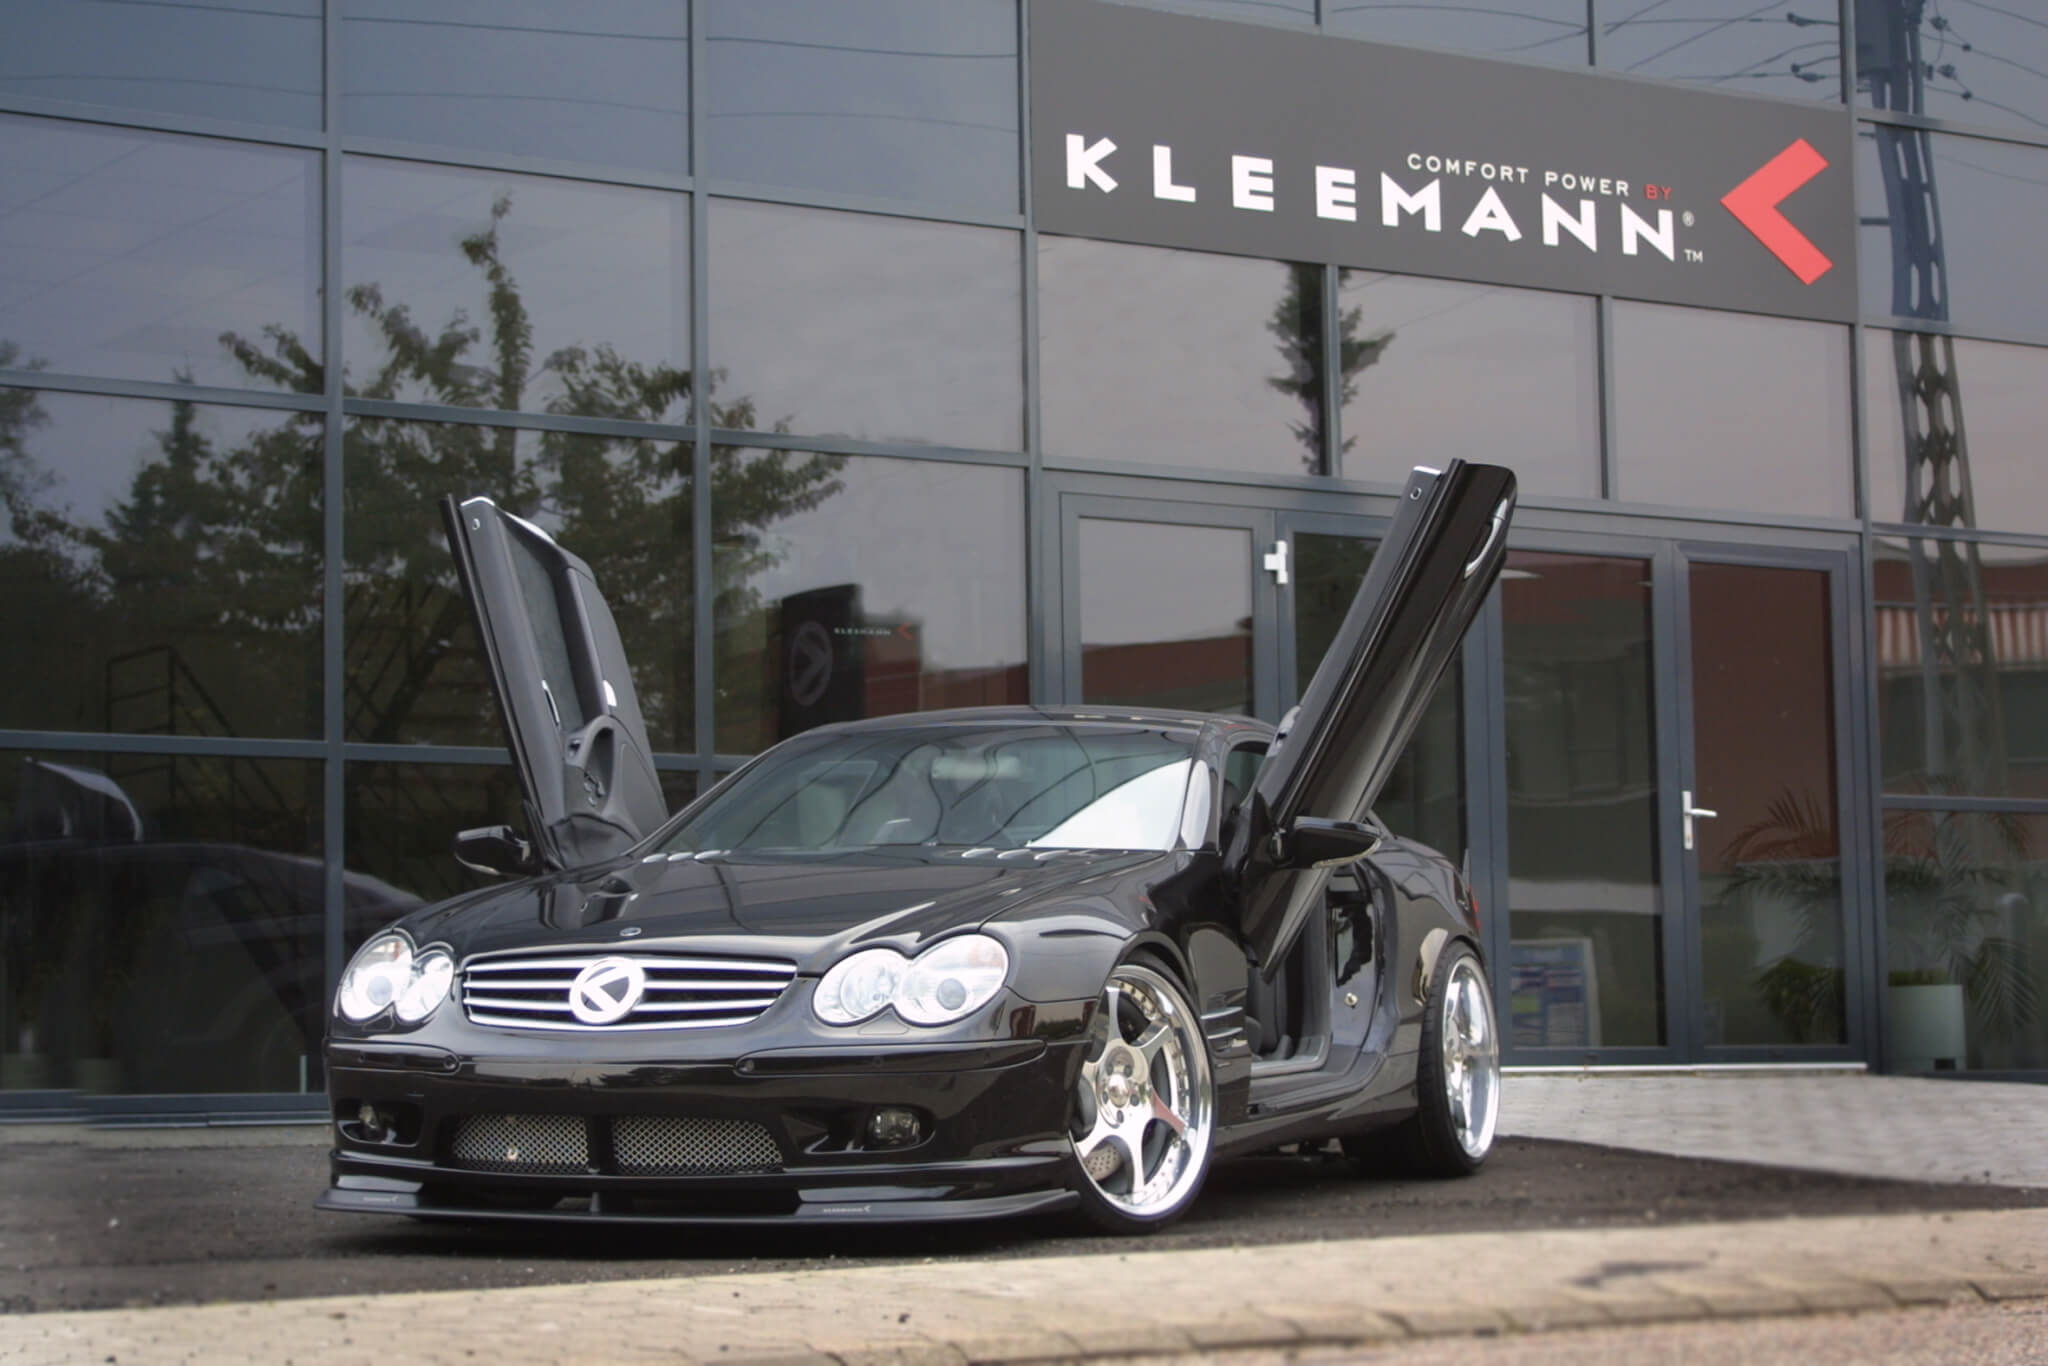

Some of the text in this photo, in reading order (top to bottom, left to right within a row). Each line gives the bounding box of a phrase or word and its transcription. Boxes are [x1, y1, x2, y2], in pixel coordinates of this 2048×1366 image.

[1066, 134, 1674, 261] KLEEMANN
[1407, 153, 1673, 200] COMFORT POWER BY
